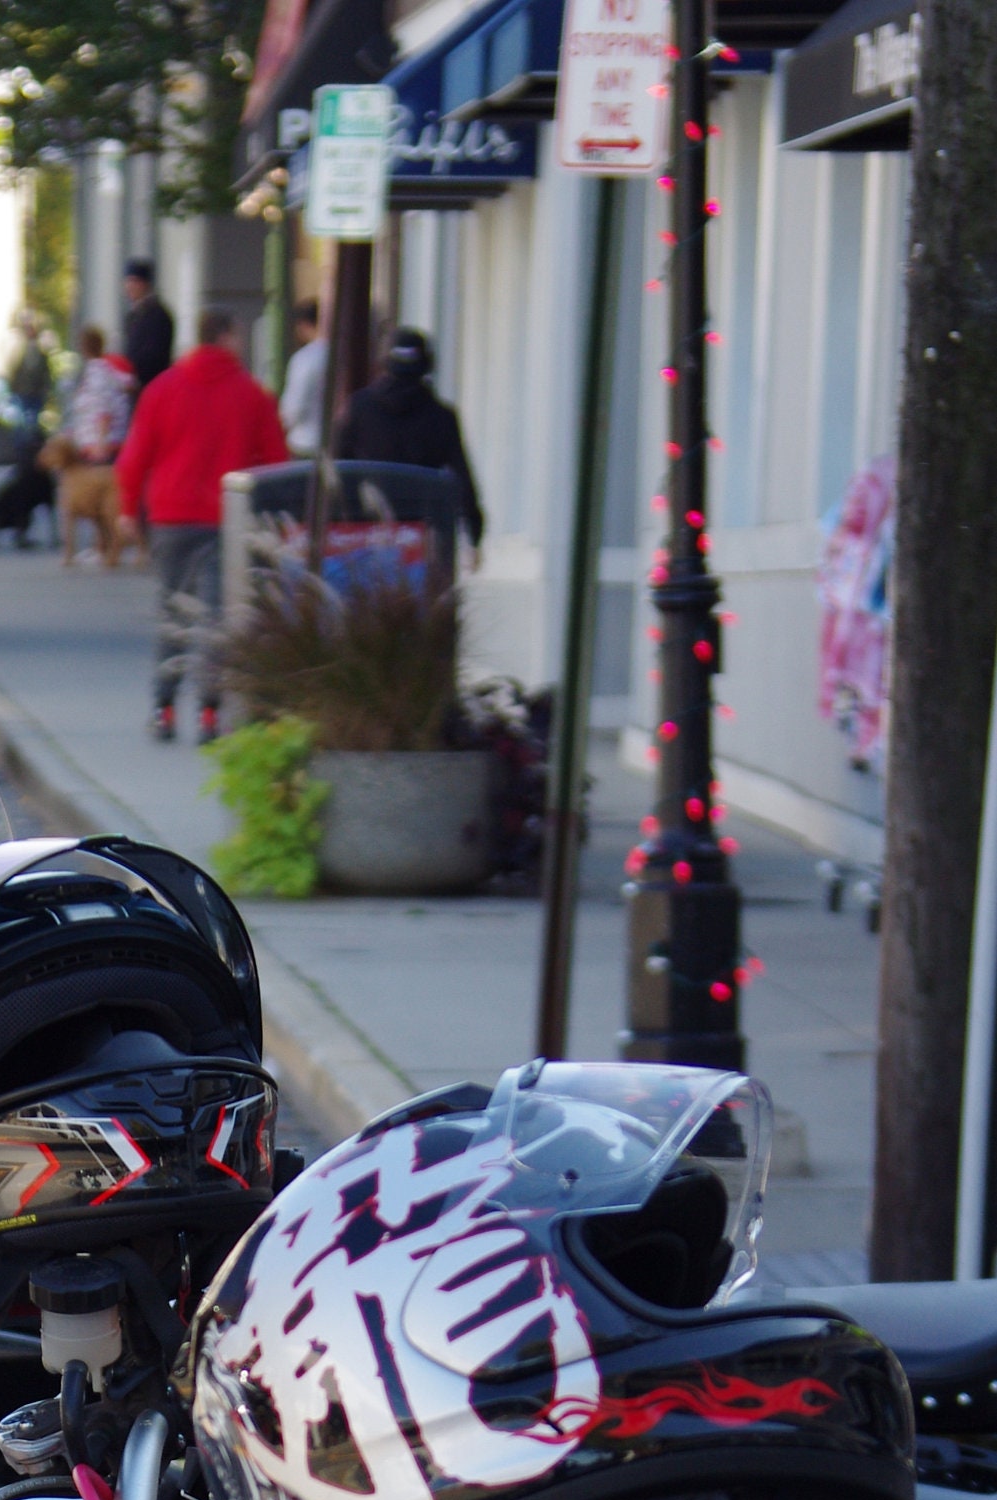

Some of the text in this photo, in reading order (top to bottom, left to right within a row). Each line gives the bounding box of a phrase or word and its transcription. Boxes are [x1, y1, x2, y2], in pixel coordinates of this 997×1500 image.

[569, 32, 665, 57] STOPPING
[594, 66, 634, 91] ANY
[590, 101, 634, 127] TIME
